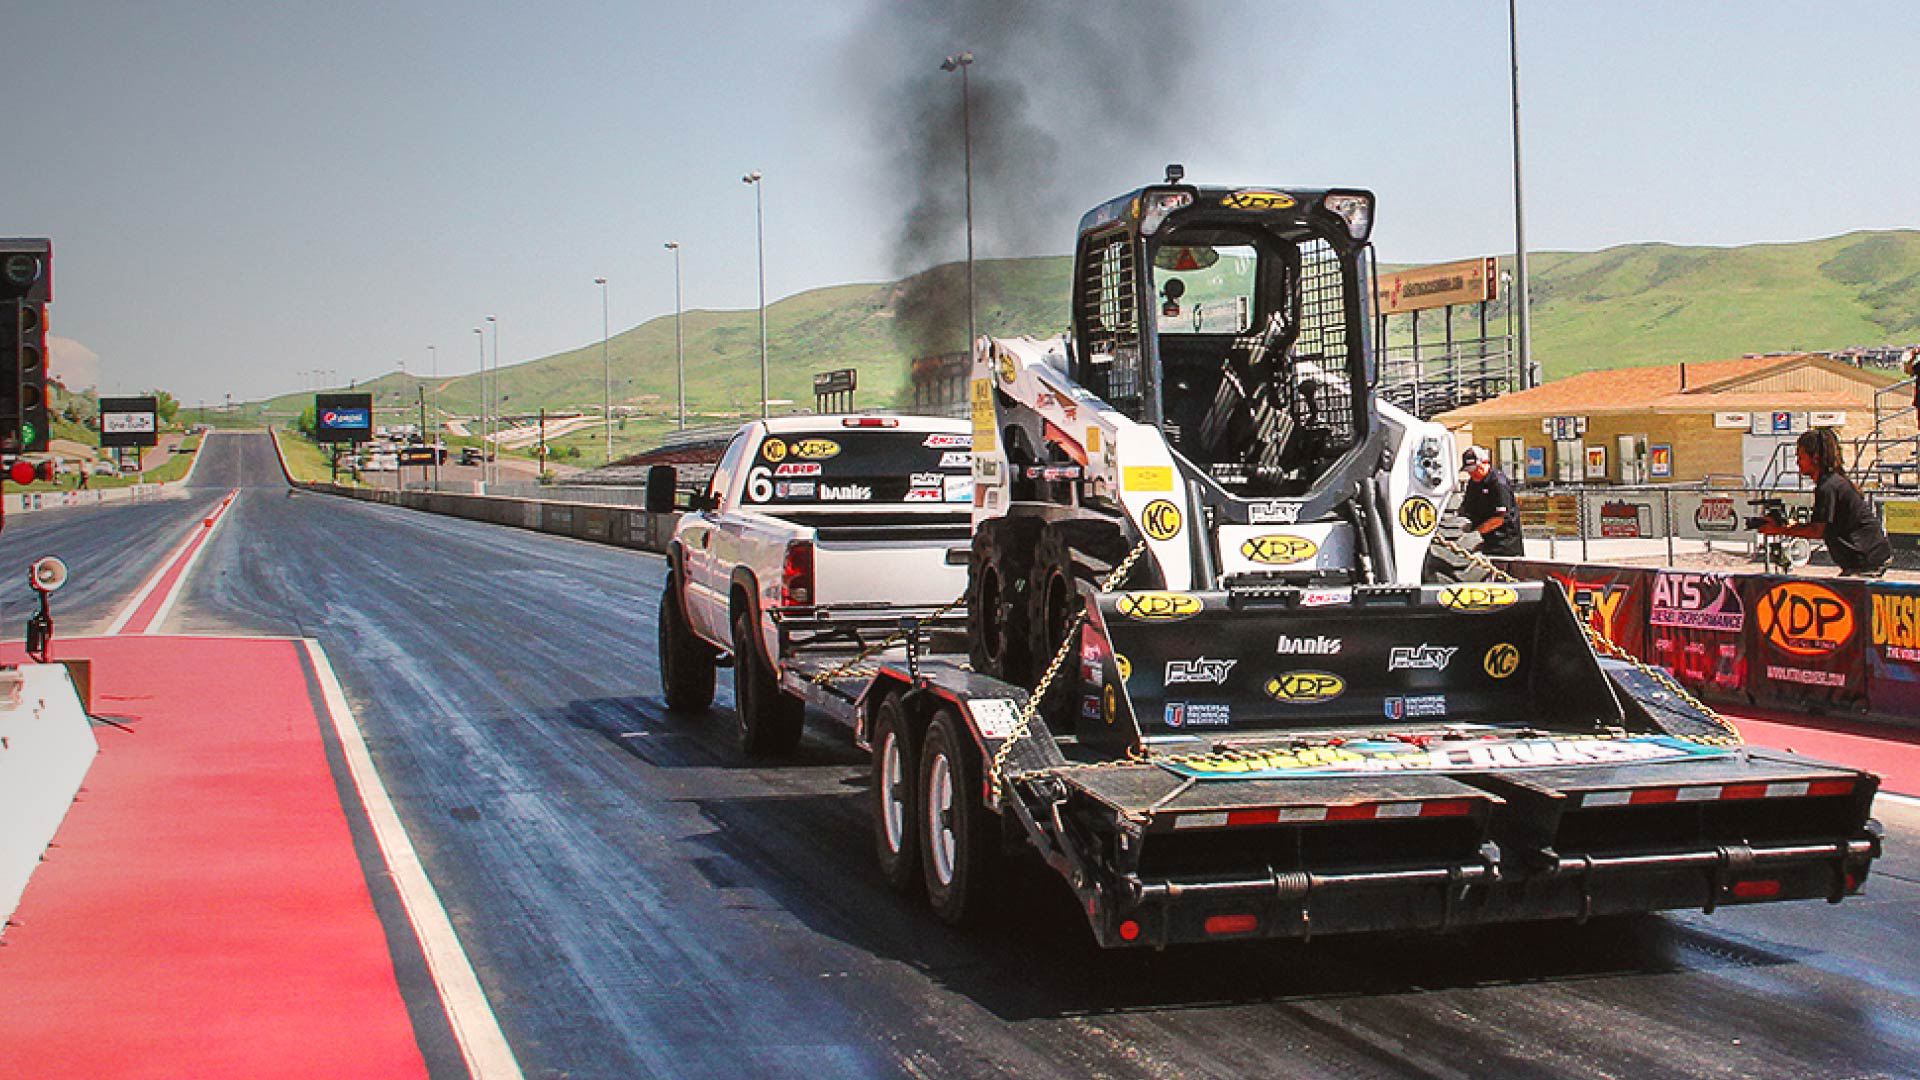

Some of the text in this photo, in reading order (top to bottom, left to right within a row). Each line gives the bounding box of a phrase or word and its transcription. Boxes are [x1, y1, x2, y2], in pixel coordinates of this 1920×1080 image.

[1229, 192, 1289, 209] XDP
[749, 466, 774, 502] 6
[820, 483, 872, 500] banks
[1147, 504, 1177, 536] KC
[1404, 500, 1432, 531] KC
[1246, 538, 1309, 561] XDP
[1446, 587, 1507, 607] XDP
[1653, 574, 1701, 609] ATS
[1126, 593, 1193, 615] XDP
[1765, 588, 1846, 645] XDP
[1276, 635, 1343, 654] banks
[1489, 646, 1516, 675] KC
[1273, 675, 1338, 697] XDP
